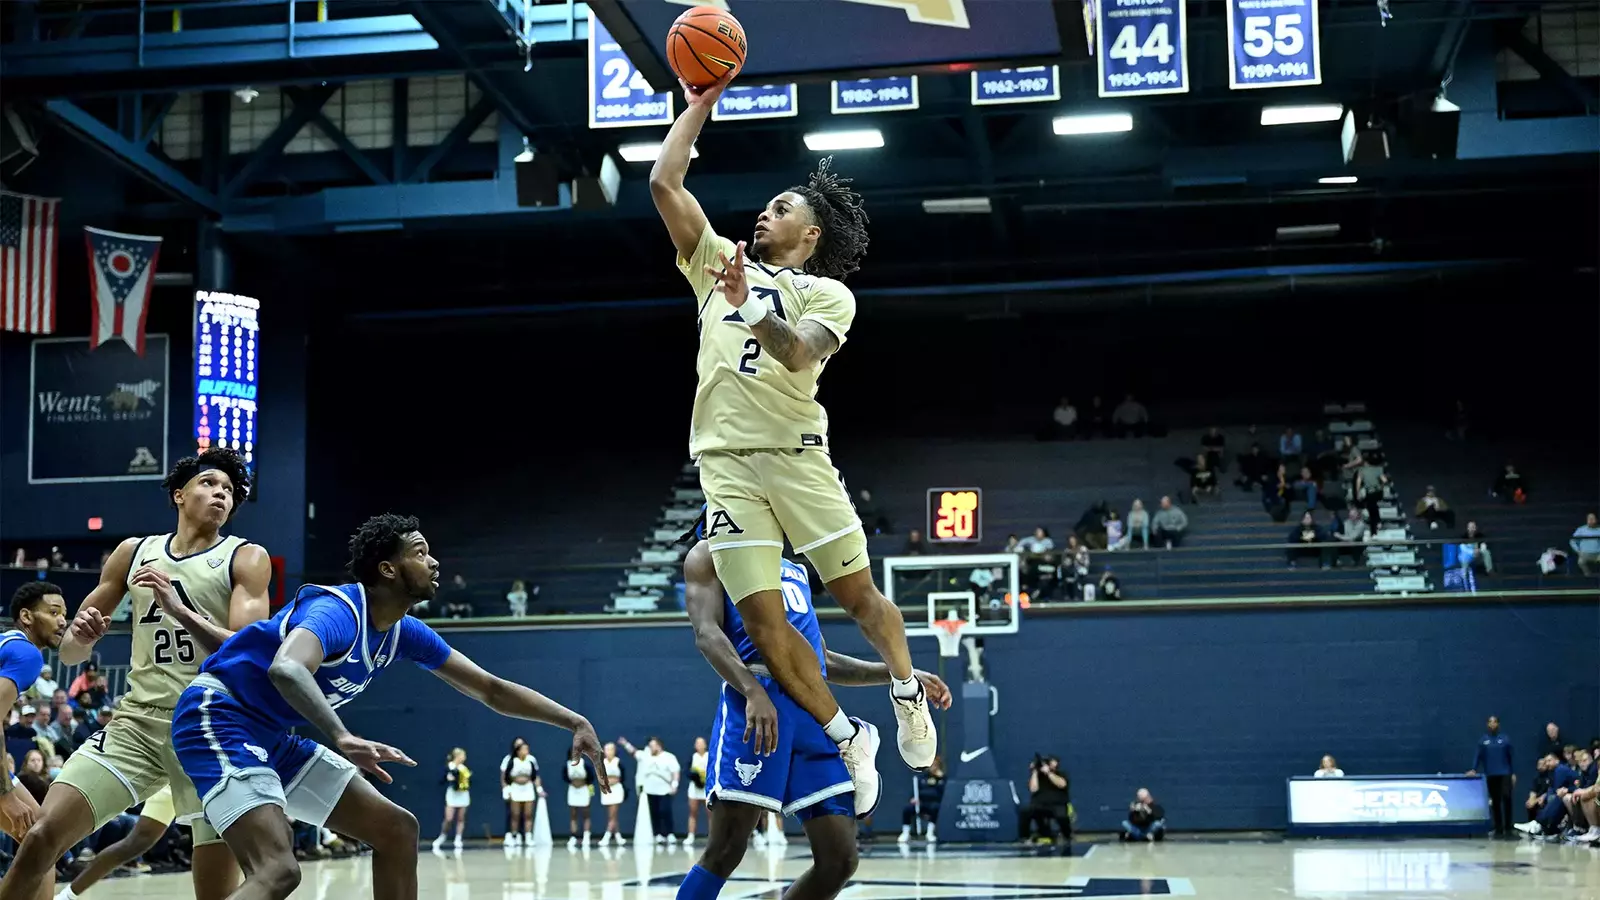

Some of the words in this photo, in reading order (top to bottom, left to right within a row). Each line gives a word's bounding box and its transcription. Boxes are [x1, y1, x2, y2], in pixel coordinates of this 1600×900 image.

[1109, 23, 1175, 65] 44
[1243, 13, 1305, 57] 55
[1108, 70, 1178, 87] 1950-1954
[1240, 62, 1308, 79] 1959-1961
[983, 77, 1048, 95] 1962-1967
[738, 337, 762, 375] 2
[39, 391, 101, 414] Wentz
[198, 379, 257, 400] BUFFALO
[708, 509, 745, 538] A
[936, 507, 973, 538] 20
[154, 627, 196, 665] 25
